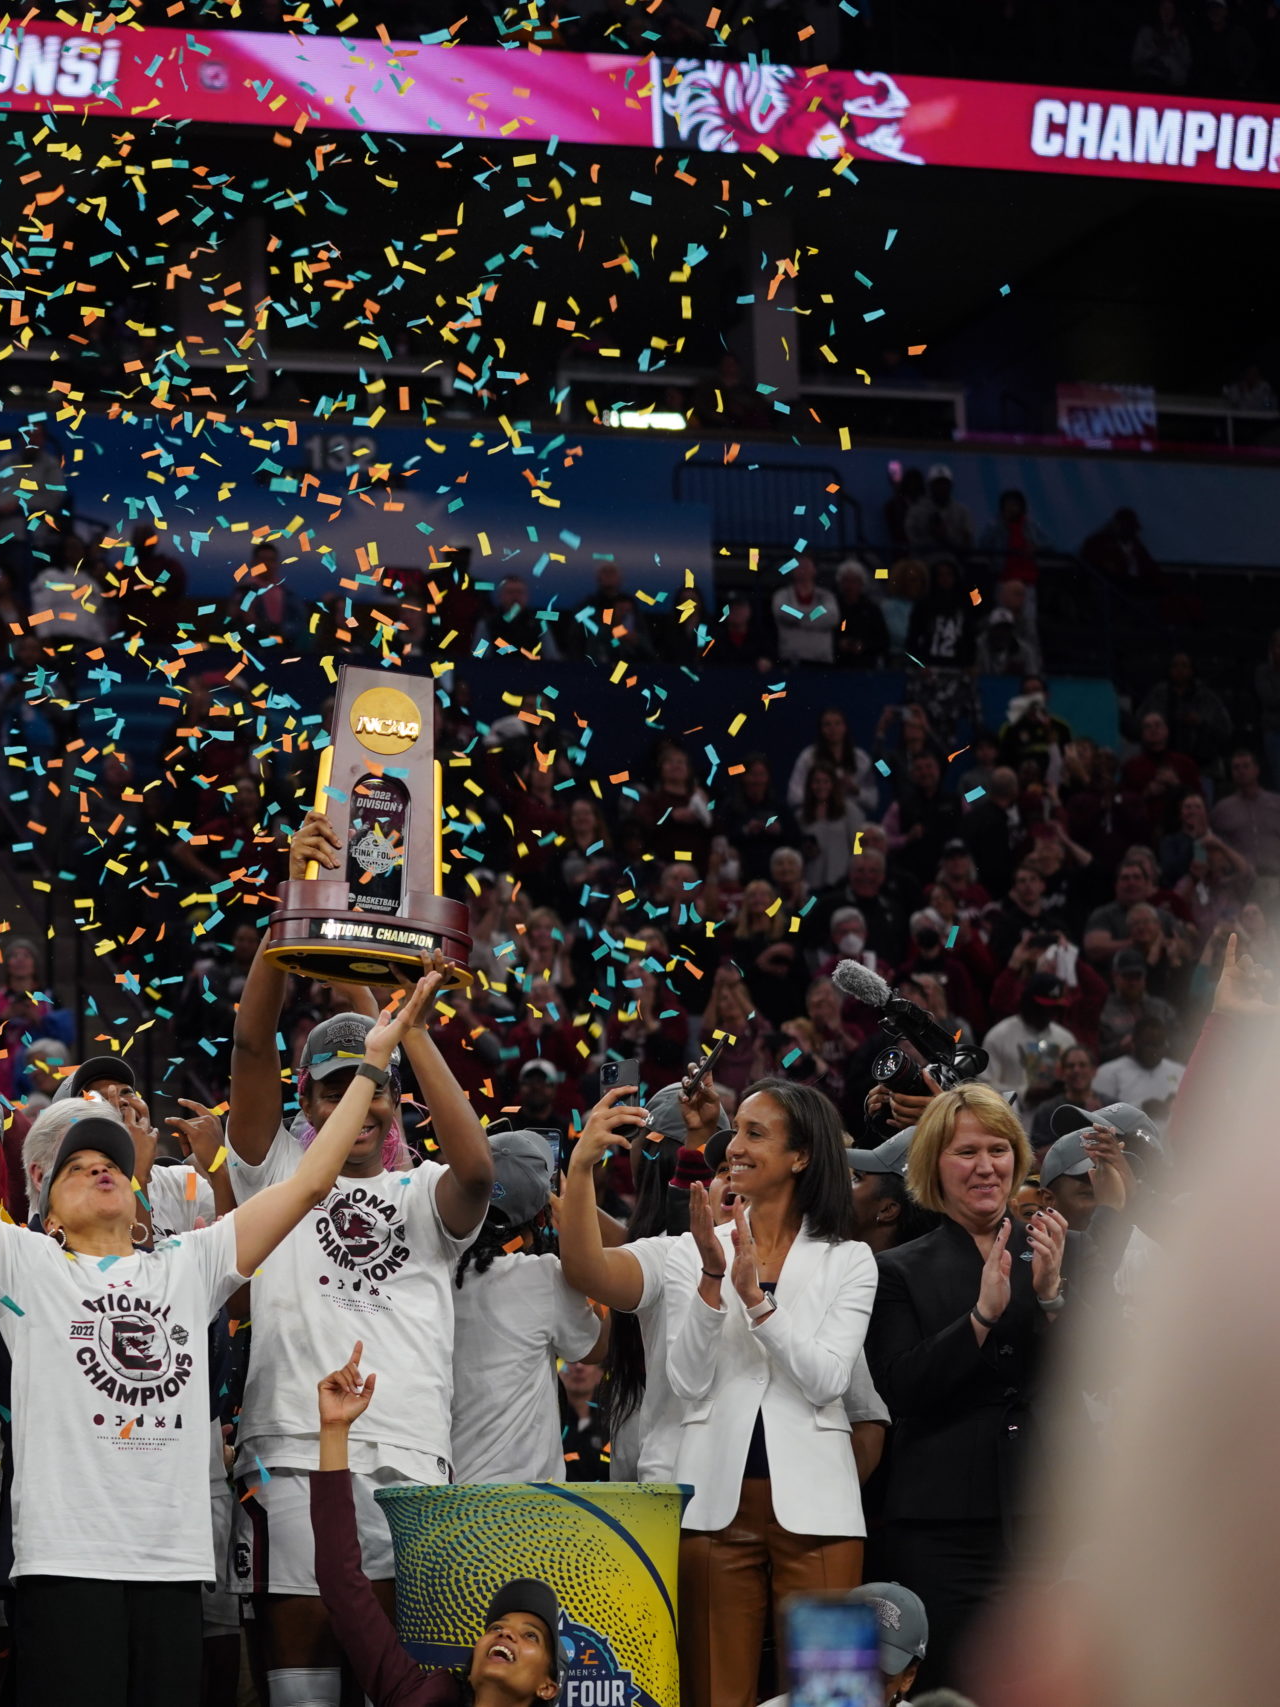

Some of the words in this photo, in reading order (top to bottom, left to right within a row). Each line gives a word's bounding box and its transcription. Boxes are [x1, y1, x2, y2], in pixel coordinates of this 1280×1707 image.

[1030, 98, 1280, 173] CHAMPIO
[356, 716, 419, 741] NCAA
[356, 798, 397, 812] DIVISION
[356, 895, 399, 907] BASKETBALL
[376, 928, 434, 949] CHAMPION
[315, 1217, 410, 1282] CHAMIONS
[70, 1325, 95, 1336] 2022
[76, 1346, 193, 1406] CHAMPIONS
[568, 1668, 597, 1677] MEN'S
[567, 1680, 625, 1707] FOUR
